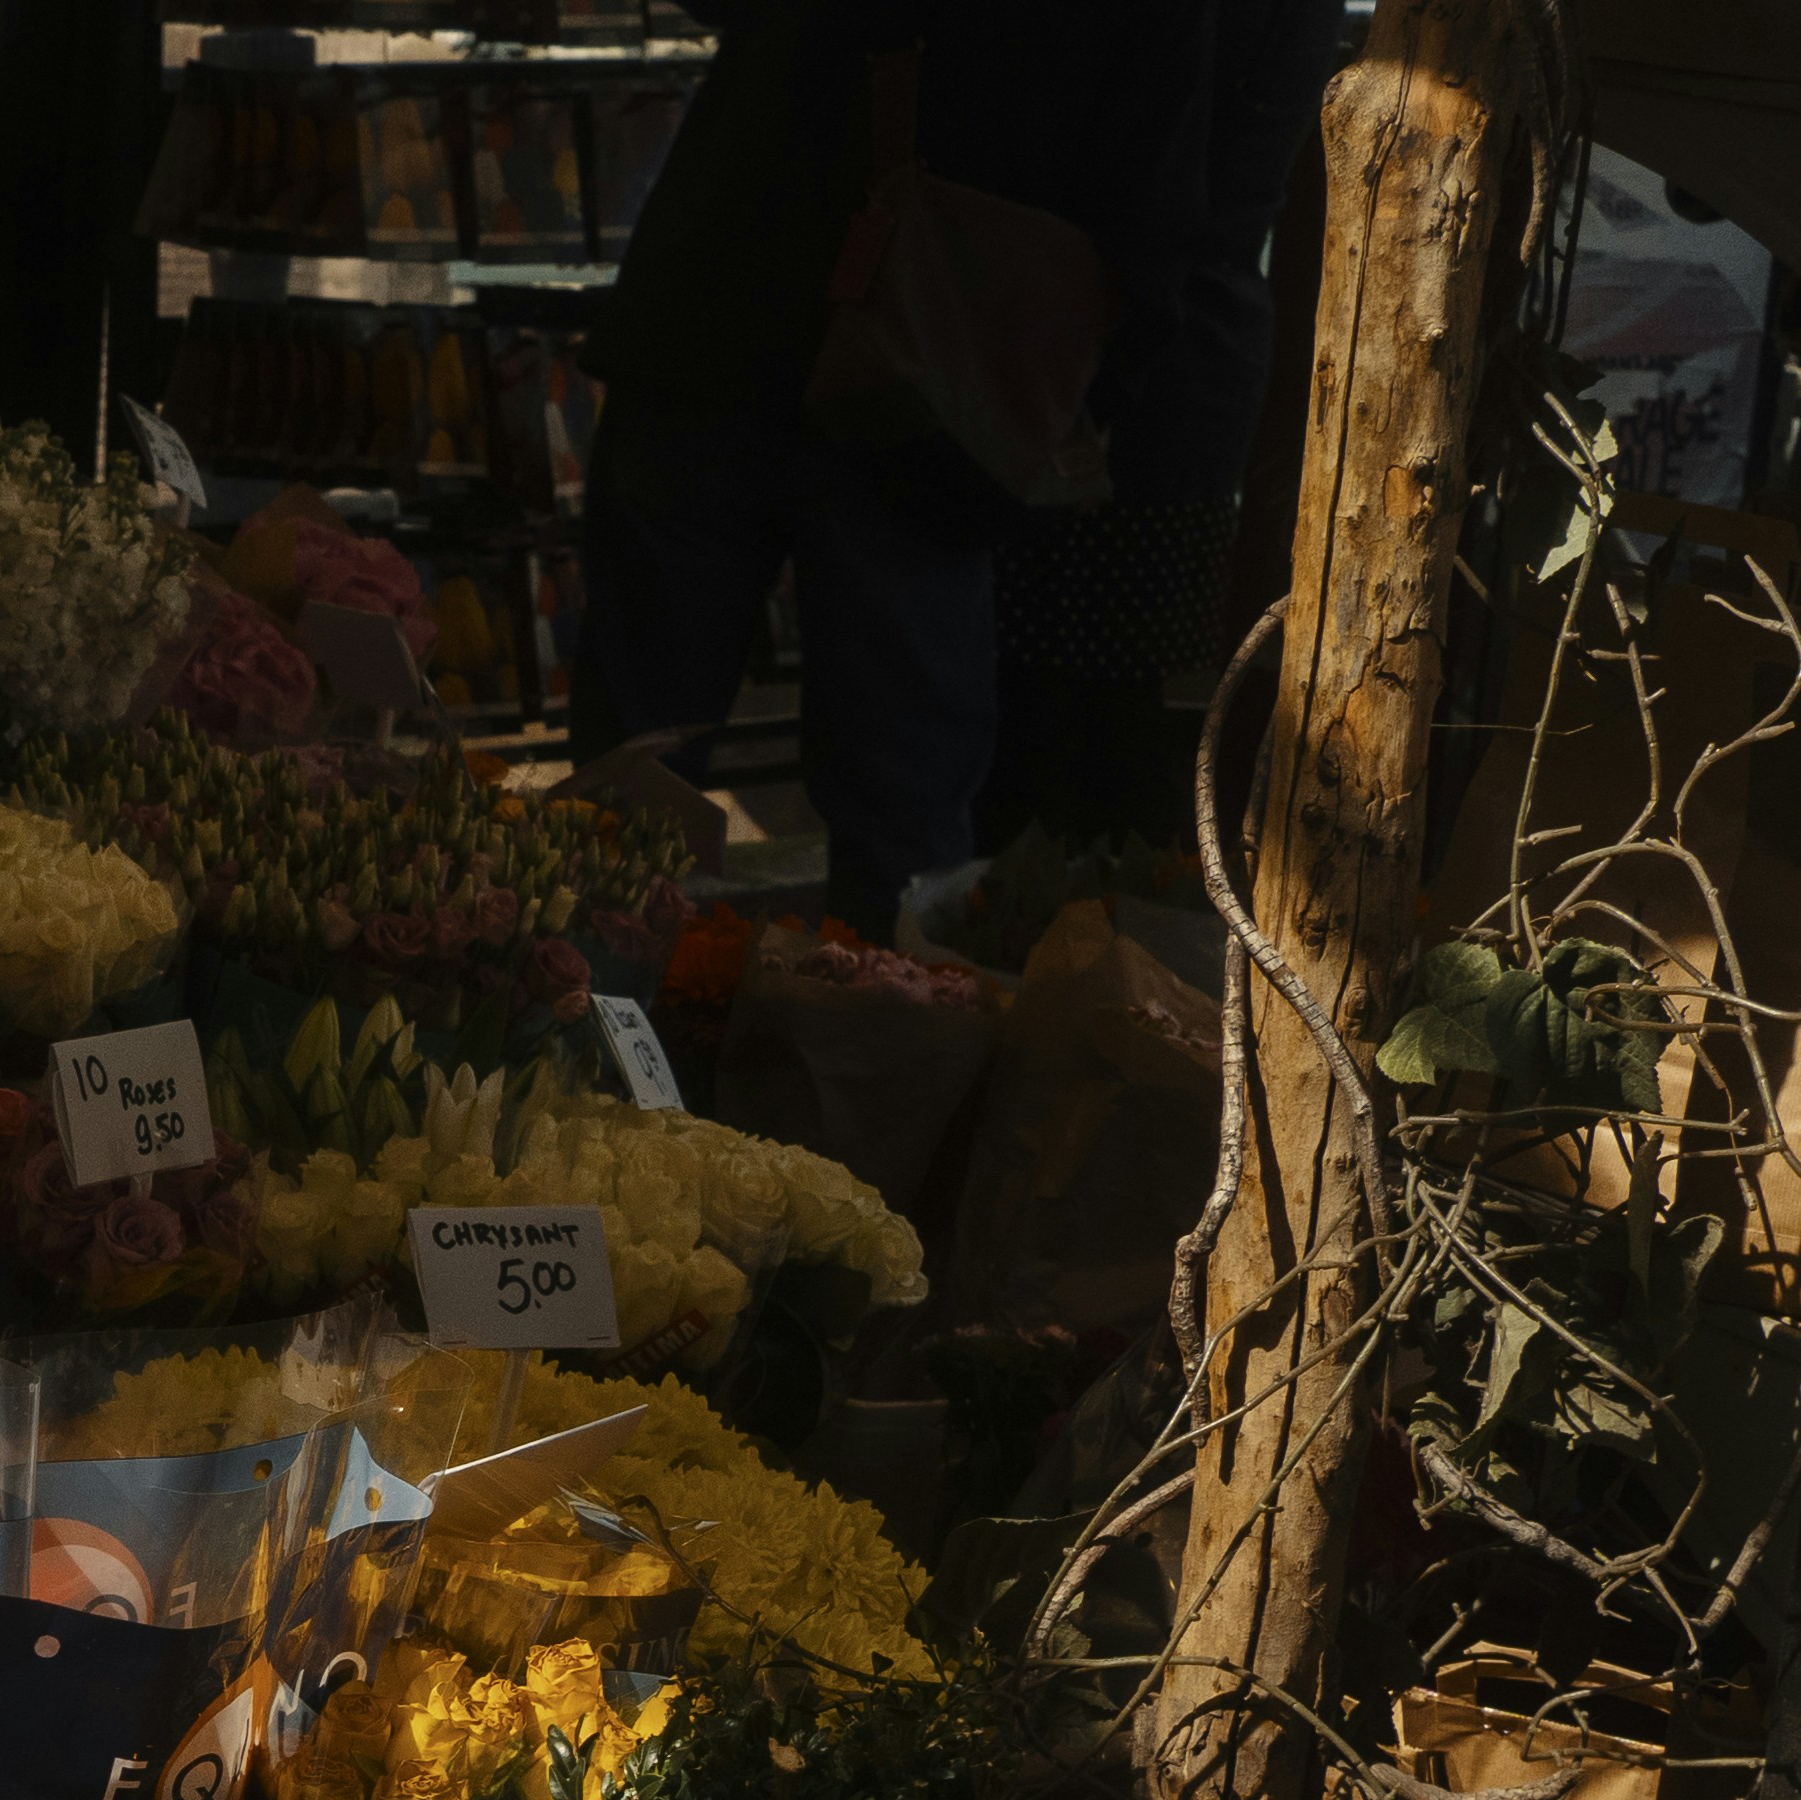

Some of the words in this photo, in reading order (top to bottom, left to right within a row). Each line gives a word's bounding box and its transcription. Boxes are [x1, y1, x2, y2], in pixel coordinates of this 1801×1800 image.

[72, 1054, 108, 1101] 10
[135, 1112, 185, 1155] 9.50
[431, 1221, 580, 1251] CHRYSANT
[497, 1257, 578, 1315] 5.00
